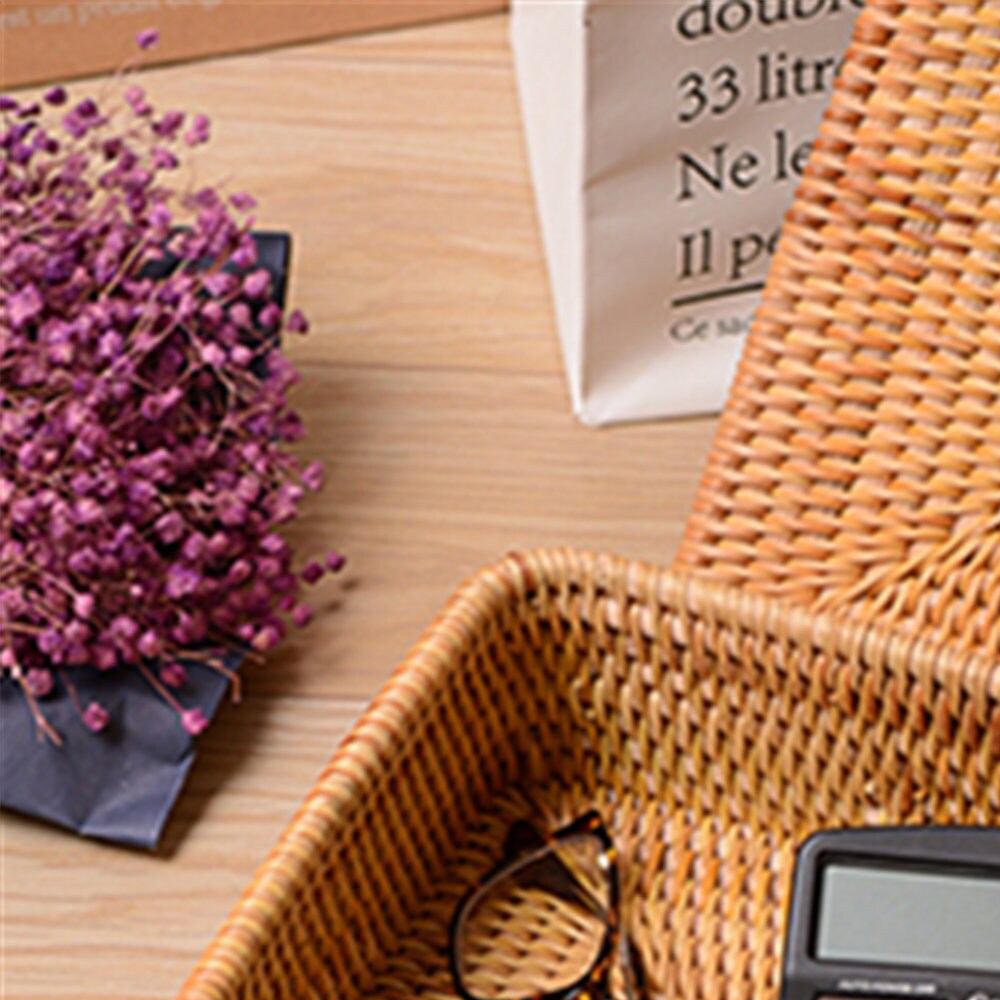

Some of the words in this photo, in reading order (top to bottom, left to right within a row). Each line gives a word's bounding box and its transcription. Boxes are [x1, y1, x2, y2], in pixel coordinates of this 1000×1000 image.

[678, 64, 741, 123] 33
[757, 53, 845, 104] litr
[676, 142, 759, 202] Ne
